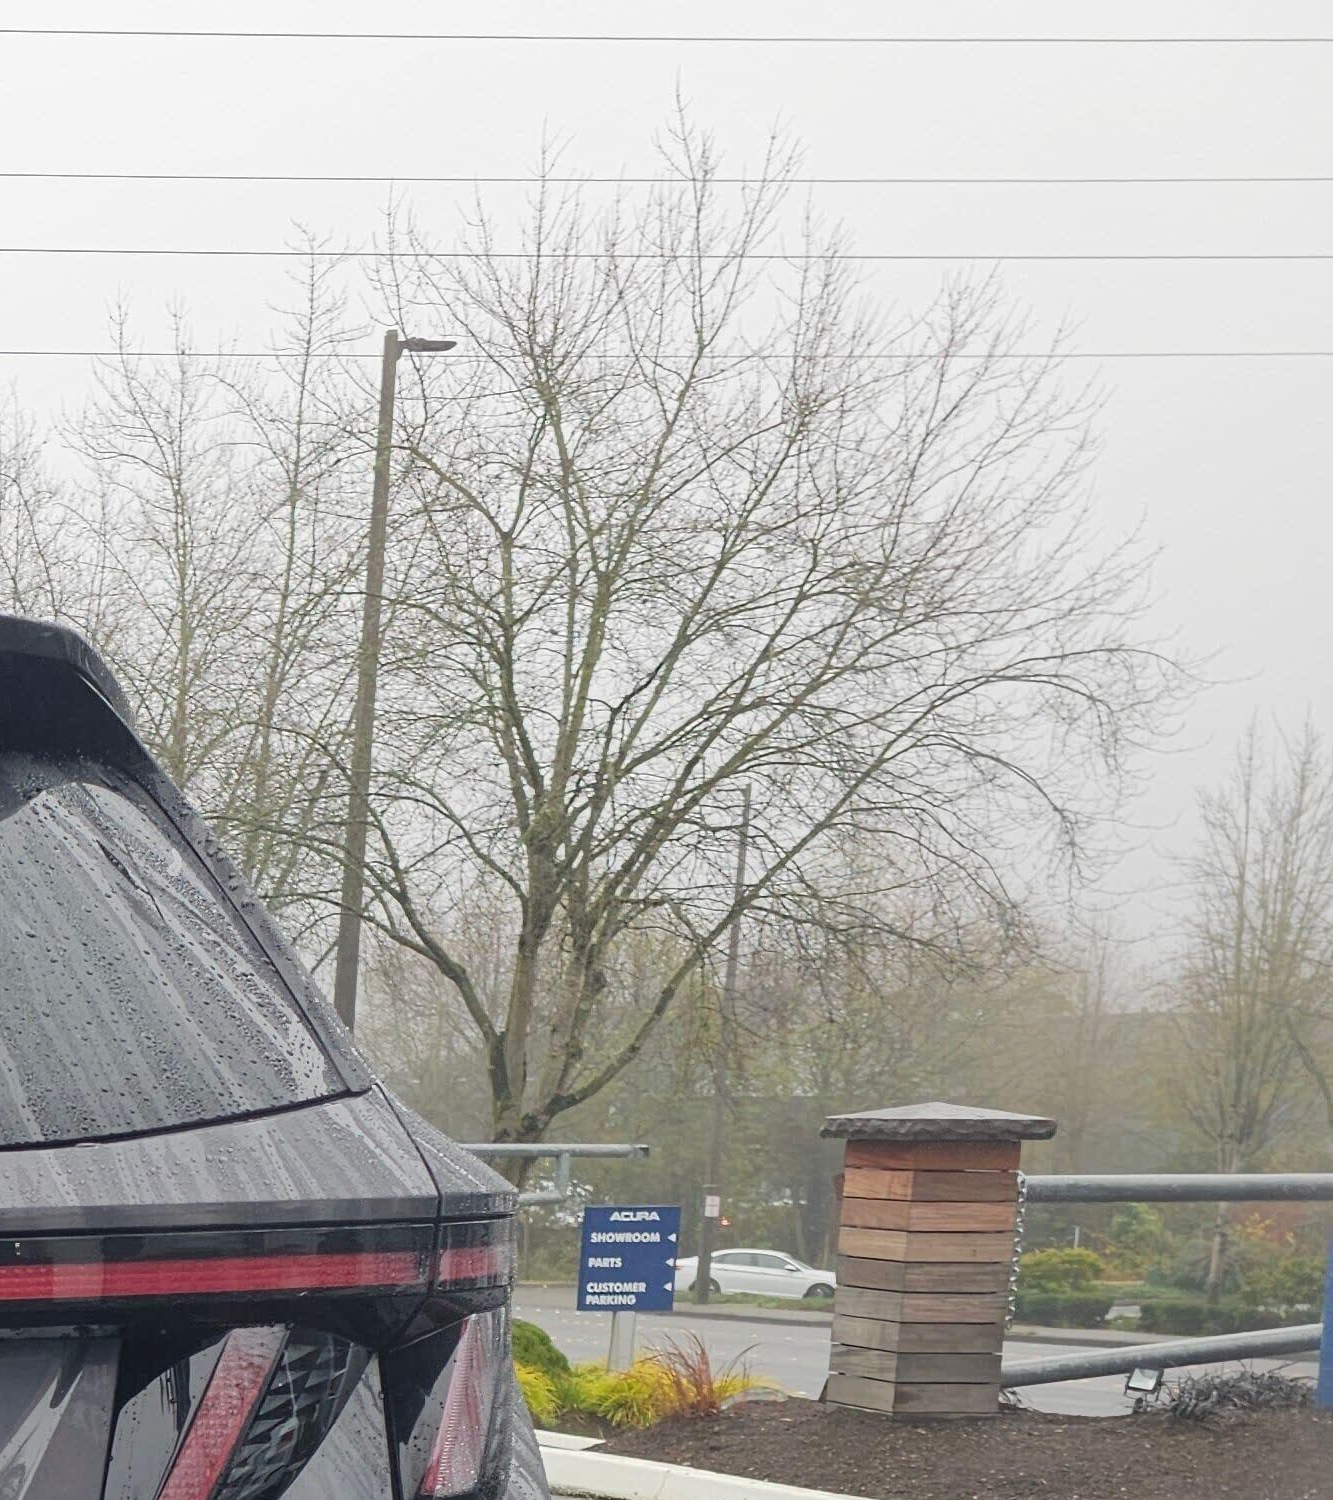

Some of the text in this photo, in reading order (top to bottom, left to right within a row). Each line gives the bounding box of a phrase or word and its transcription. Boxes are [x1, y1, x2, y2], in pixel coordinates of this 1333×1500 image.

[610, 1211, 660, 1221] ACURA
[590, 1232, 660, 1242] SHOWROOM
[588, 1257, 623, 1268] PARTS
[586, 1282, 647, 1293] CUSTOMER
[585, 1294, 637, 1305] PARKING
